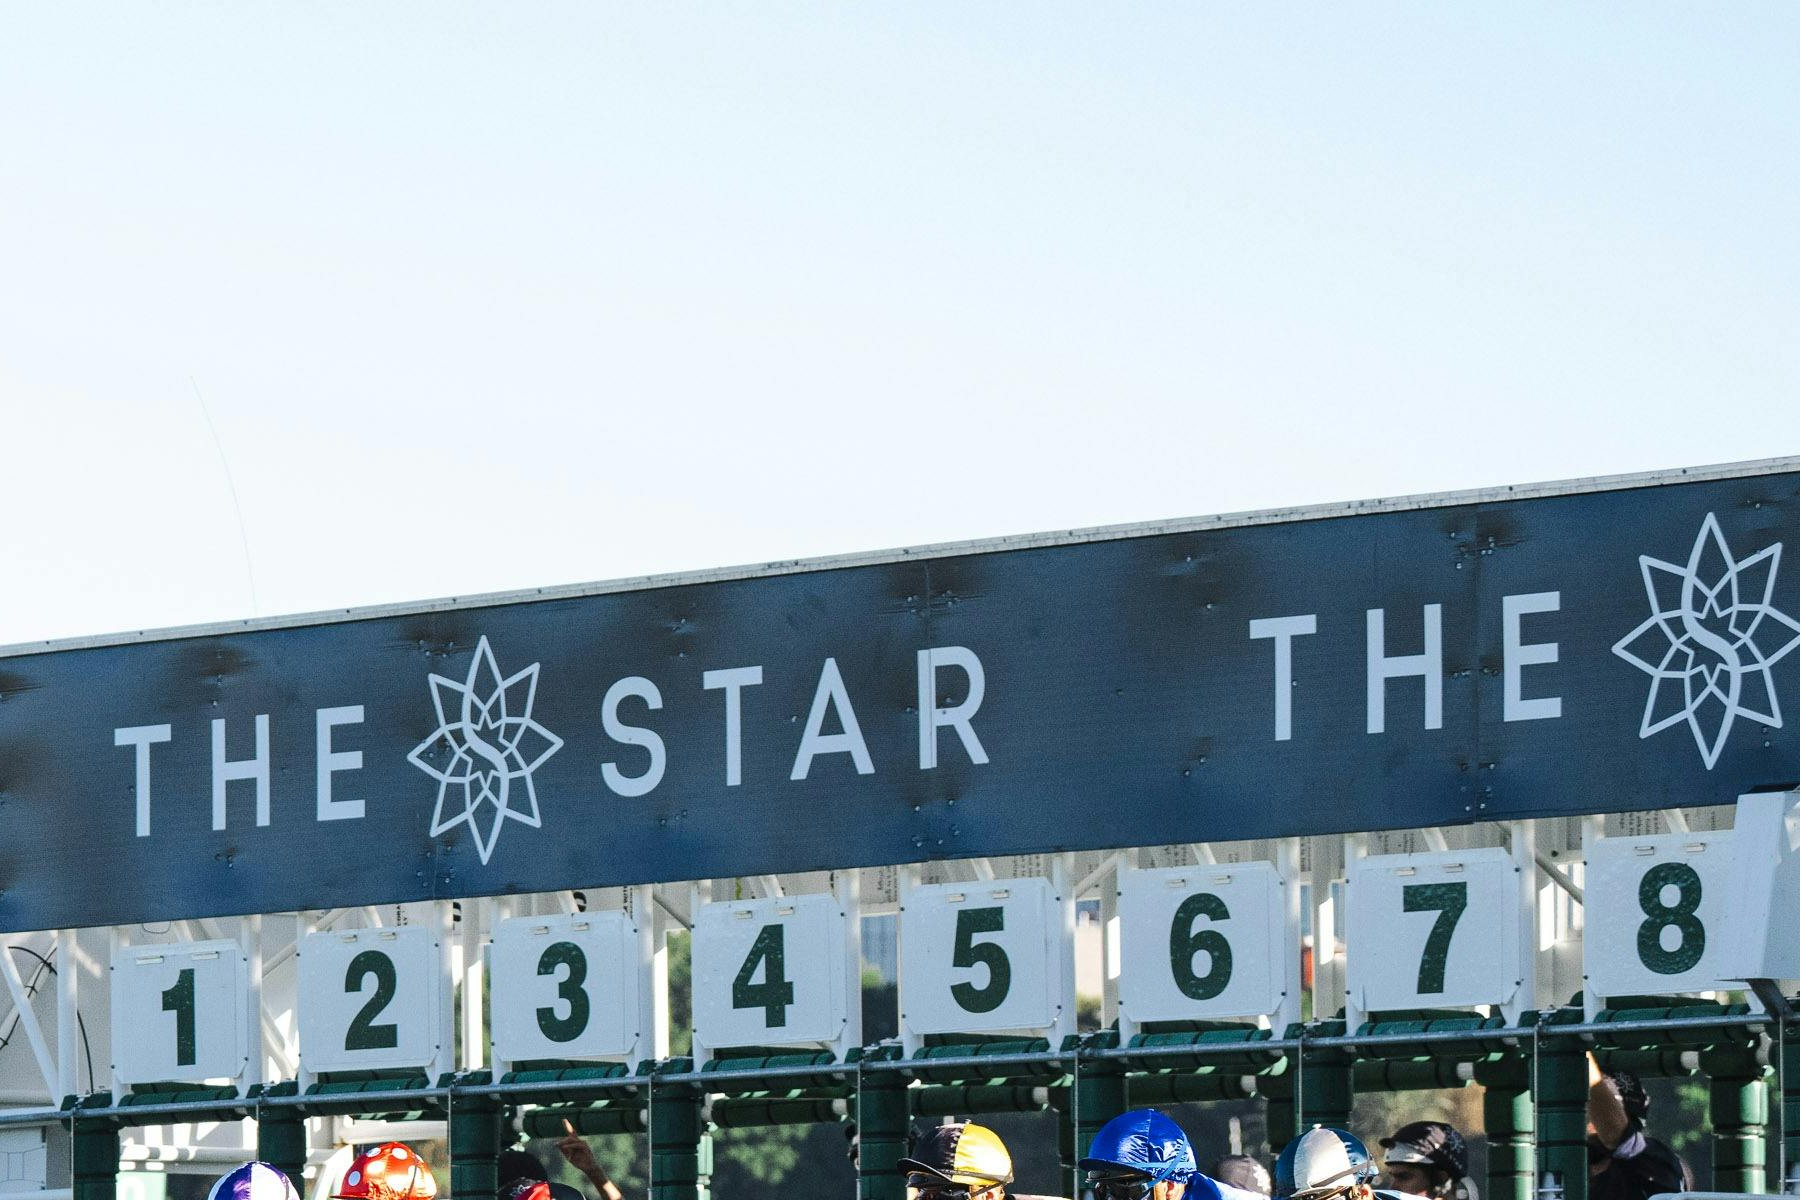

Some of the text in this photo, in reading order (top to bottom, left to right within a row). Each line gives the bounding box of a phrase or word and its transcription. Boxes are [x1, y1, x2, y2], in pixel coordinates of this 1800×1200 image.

[113, 589, 1563, 839] THE STAR THE
[949, 905, 1012, 1015] 5
[1168, 891, 1234, 1002] 6
[1402, 880, 1469, 996] 7
[1635, 861, 1707, 976] 8
[160, 967, 197, 1068] 1
[343, 949, 399, 1052] 2
[535, 940, 591, 1044] 3
[731, 922, 795, 1030] 4
